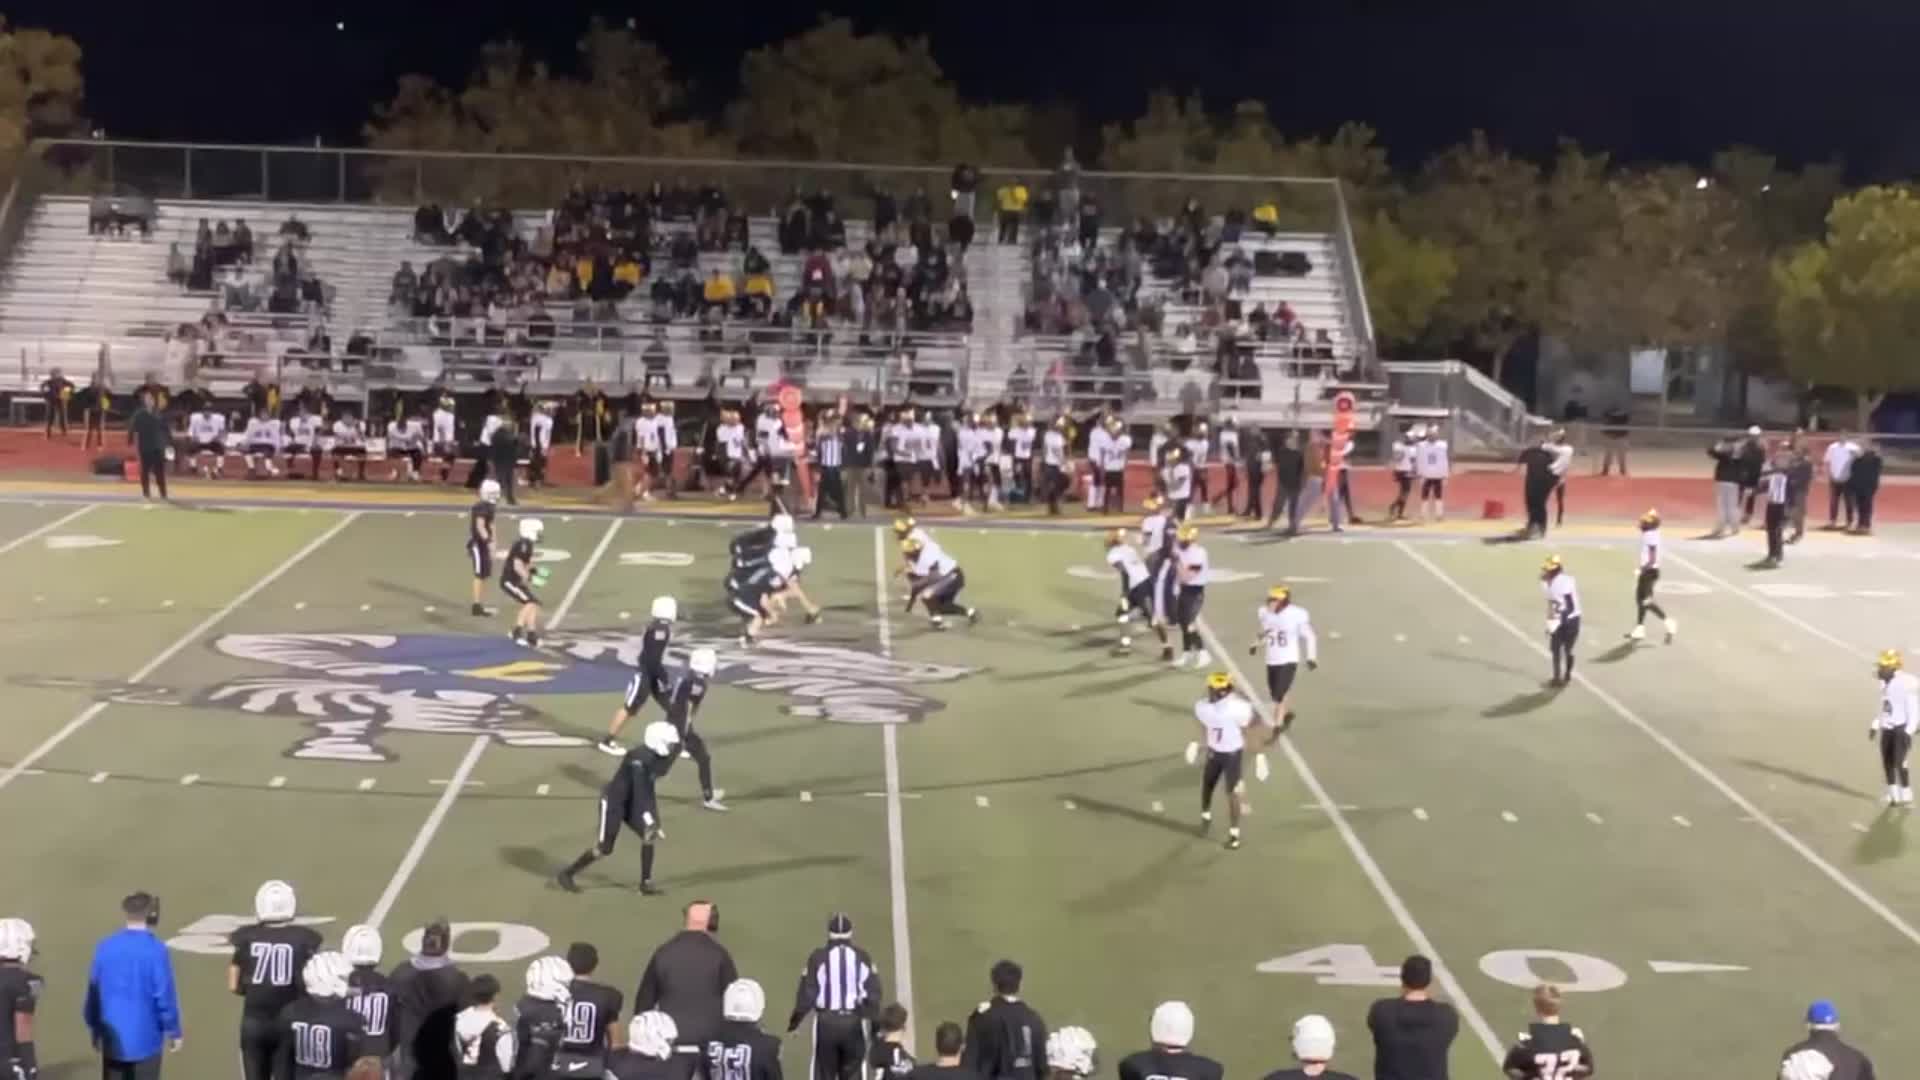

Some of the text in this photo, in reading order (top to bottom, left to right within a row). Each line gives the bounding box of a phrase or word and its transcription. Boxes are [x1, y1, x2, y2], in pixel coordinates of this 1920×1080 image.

[1212, 727, 1224, 743] 7
[250, 942, 293, 986] 70
[291, 1021, 332, 1069] 18
